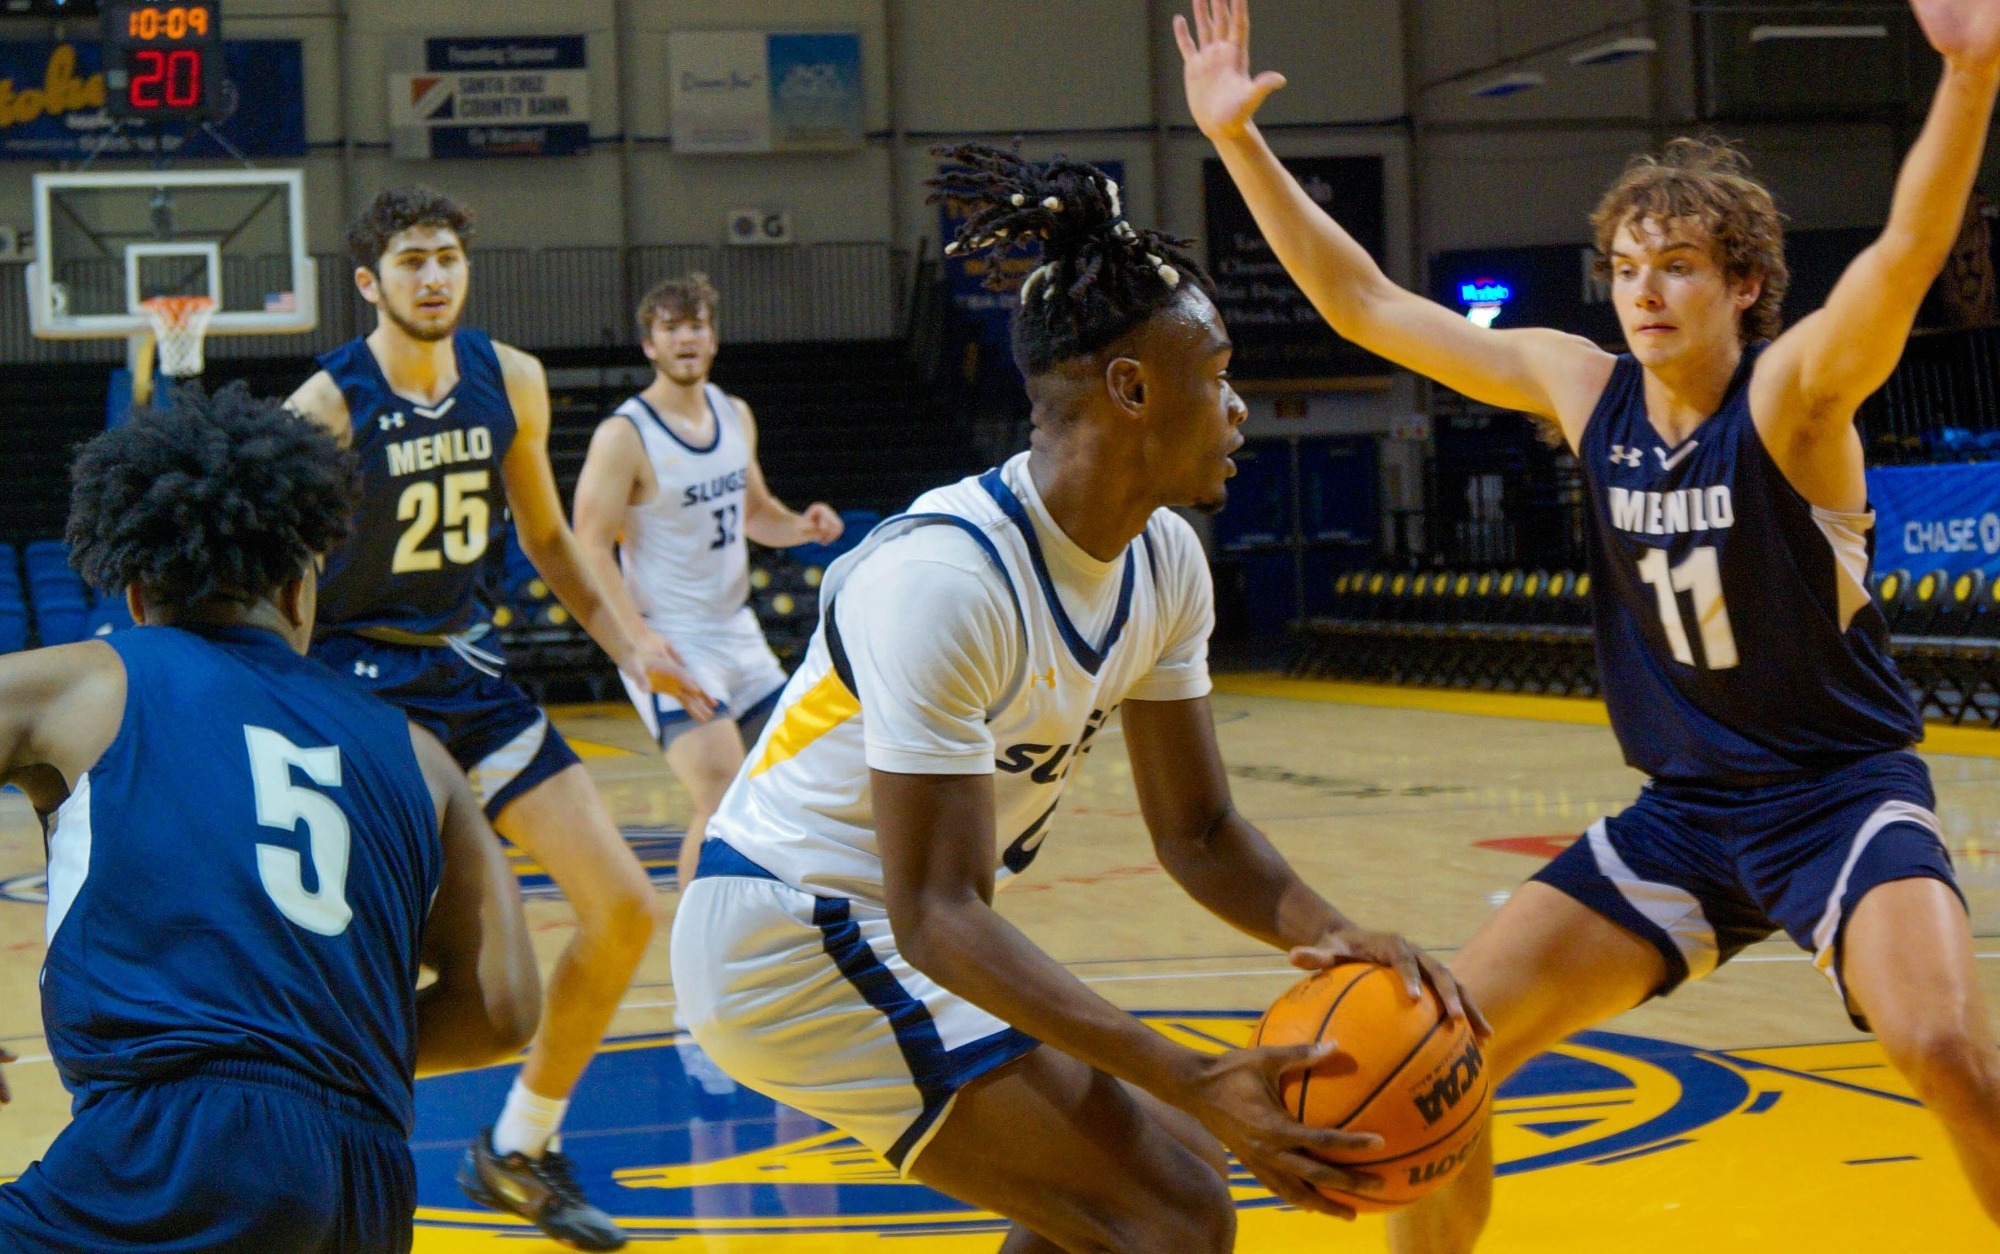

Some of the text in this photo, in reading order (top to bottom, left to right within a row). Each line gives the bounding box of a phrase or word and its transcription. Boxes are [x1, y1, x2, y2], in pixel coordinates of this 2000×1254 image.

[129, 6, 208, 40] 10:09
[130, 50, 200, 108] 20
[458, 77, 503, 93] SANTA
[459, 96, 569, 116] COUNTY BANK
[763, 214, 784, 238] G
[386, 427, 492, 476] MENLO
[392, 471, 490, 574] 25
[1608, 485, 1735, 535] MENLO
[1903, 517, 1978, 554] CHASE
[1637, 546, 1740, 670] 11
[243, 724, 353, 936] 5
[1413, 1035, 1483, 1126] NCAA
